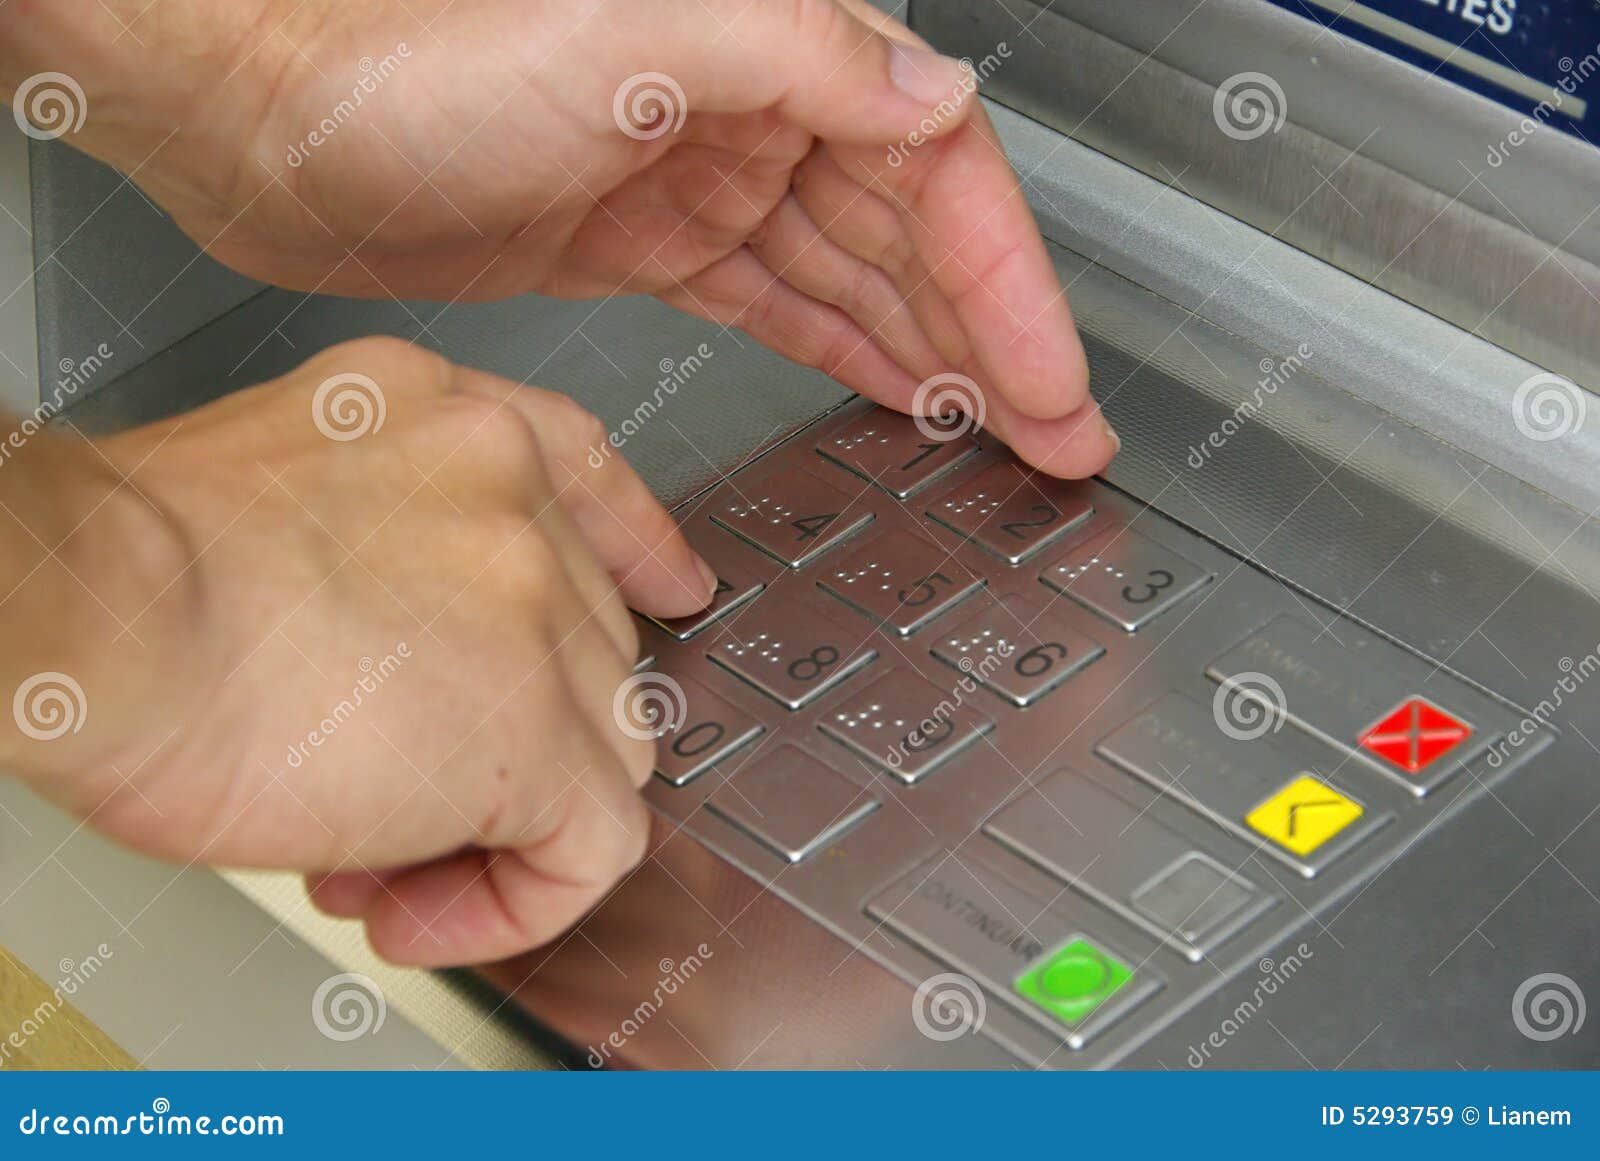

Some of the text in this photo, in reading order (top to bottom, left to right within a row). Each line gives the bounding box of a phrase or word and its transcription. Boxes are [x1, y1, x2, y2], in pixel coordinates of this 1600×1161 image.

[901, 443, 945, 471] 1
[791, 512, 842, 542] 4
[1000, 504, 1058, 541] 2
[896, 571, 955, 608] 5
[1121, 569, 1175, 605] 3
[786, 645, 840, 682] 8
[1013, 641, 1068, 678] 6
[671, 720, 726, 757] 0
[906, 874, 1045, 963] ONTINUAR
